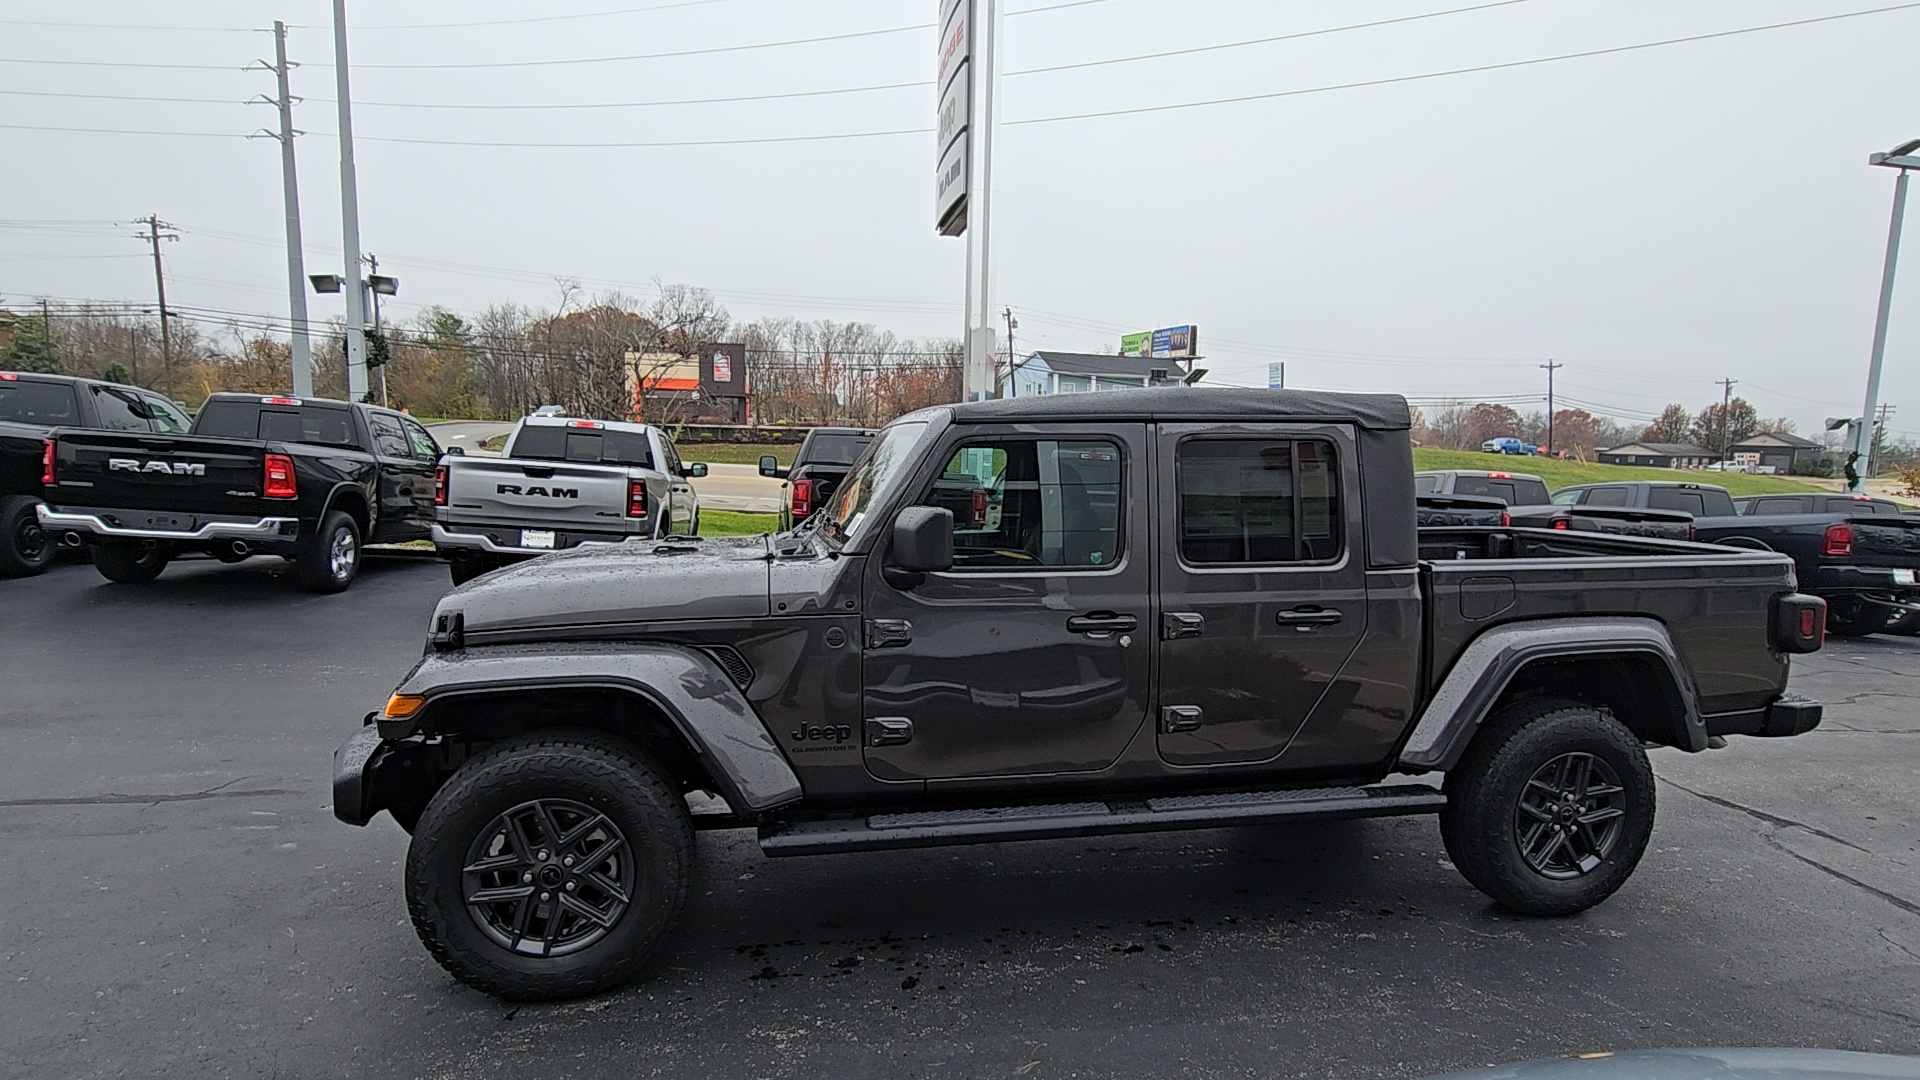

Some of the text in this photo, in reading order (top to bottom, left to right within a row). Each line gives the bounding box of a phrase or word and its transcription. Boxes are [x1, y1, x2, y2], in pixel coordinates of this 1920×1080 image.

[109, 457, 206, 476] RAM
[496, 484, 579, 499] RAM
[790, 719, 851, 744] Jeep
[792, 745, 846, 753] GLADIATOR
